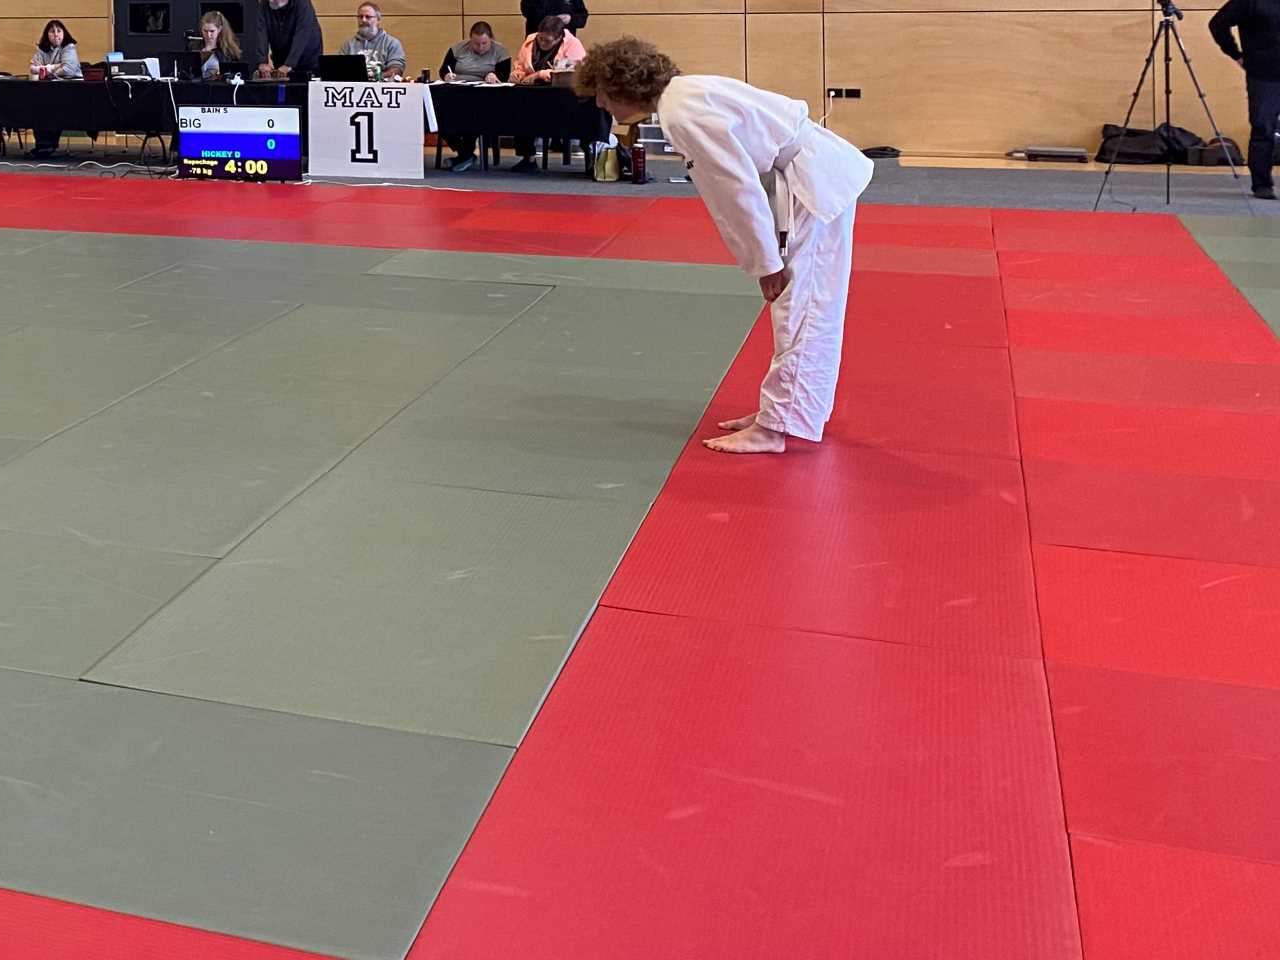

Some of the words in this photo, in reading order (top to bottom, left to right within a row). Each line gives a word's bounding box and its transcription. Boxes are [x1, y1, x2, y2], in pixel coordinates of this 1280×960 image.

[324, 86, 406, 108] MAT
[179, 118, 202, 129] BIG
[267, 119, 274, 129] 0
[349, 111, 378, 163] 1
[266, 139, 276, 150] 0
[201, 150, 232, 158] HICKEY
[202, 167, 213, 176] kg
[224, 159, 268, 175] 4:00
